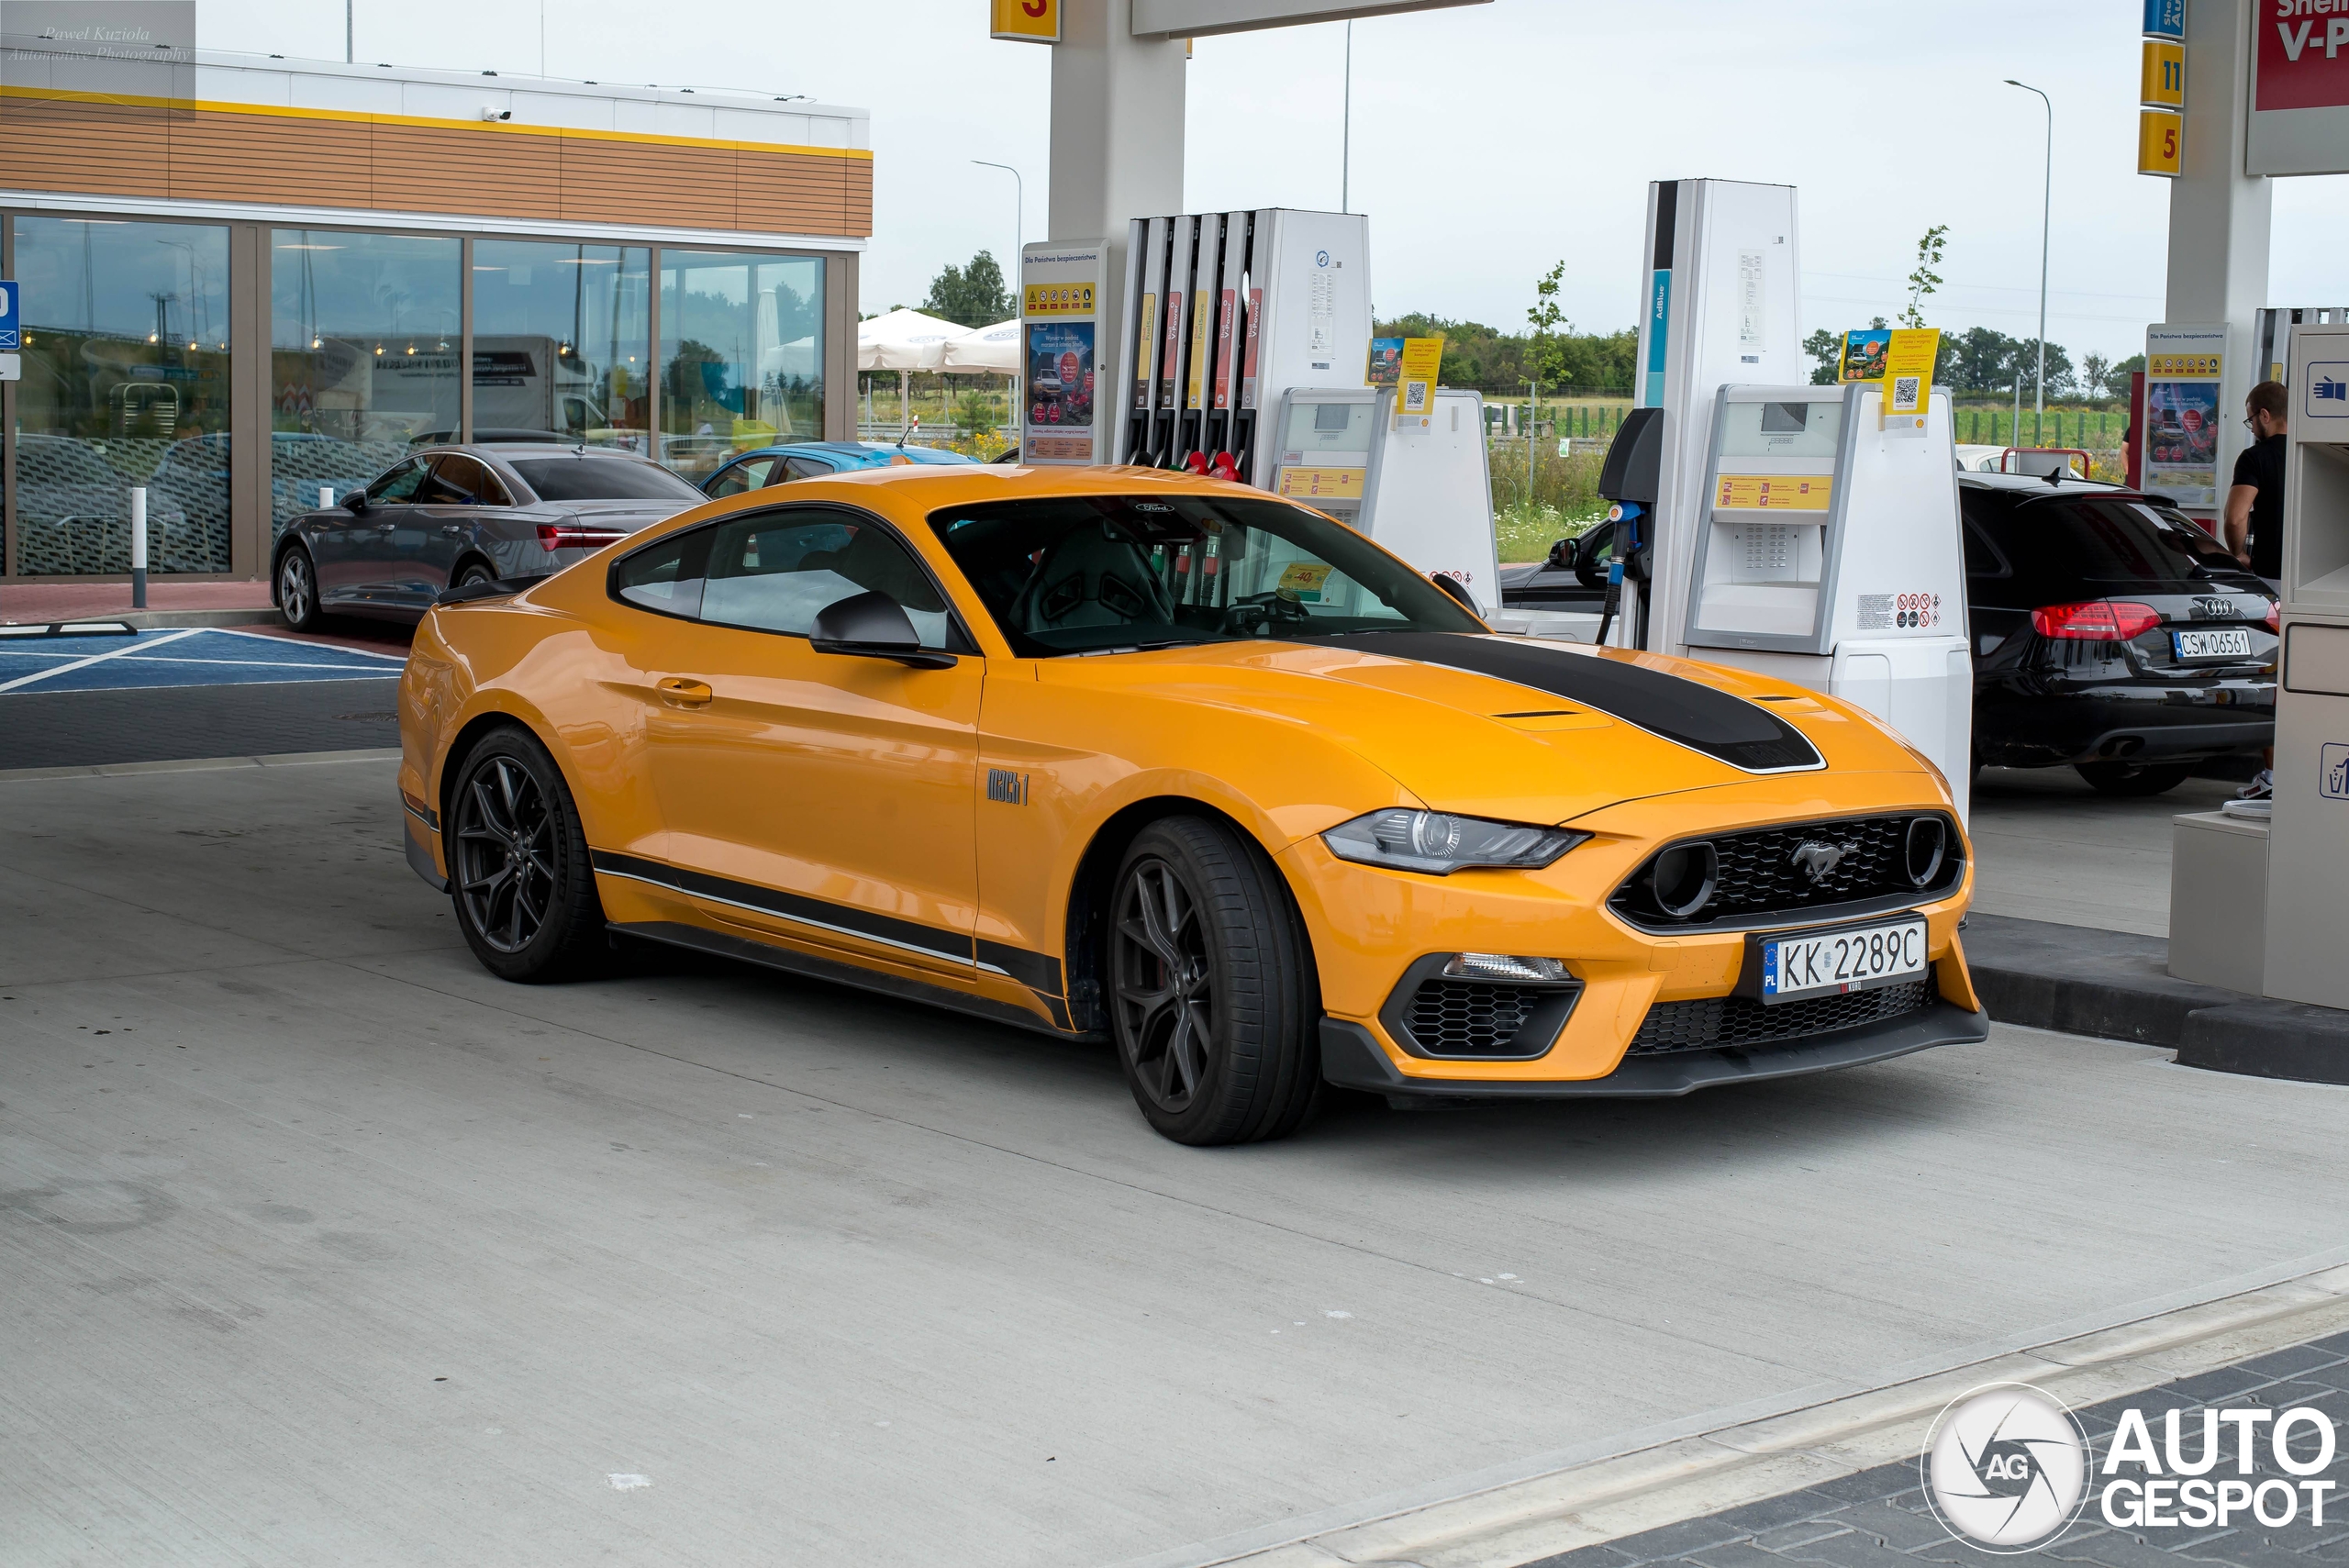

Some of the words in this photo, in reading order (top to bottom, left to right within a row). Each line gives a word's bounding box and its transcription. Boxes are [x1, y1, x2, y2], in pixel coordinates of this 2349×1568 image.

[2164, 61, 2180, 92] 11
[2163, 128, 2176, 159] 5
[1057, 253, 1097, 263] bezpieczeństwa
[1655, 285, 1665, 320] AdBlue
[1171, 304, 1179, 339] V-Power
[1252, 301, 1260, 337] V-Power
[2181, 633, 2208, 654] CSW
[2210, 632, 2247, 653] 06561
[1784, 941, 1821, 988] KK
[1834, 927, 1918, 981] 2289C
[1765, 975, 1776, 987] PL
